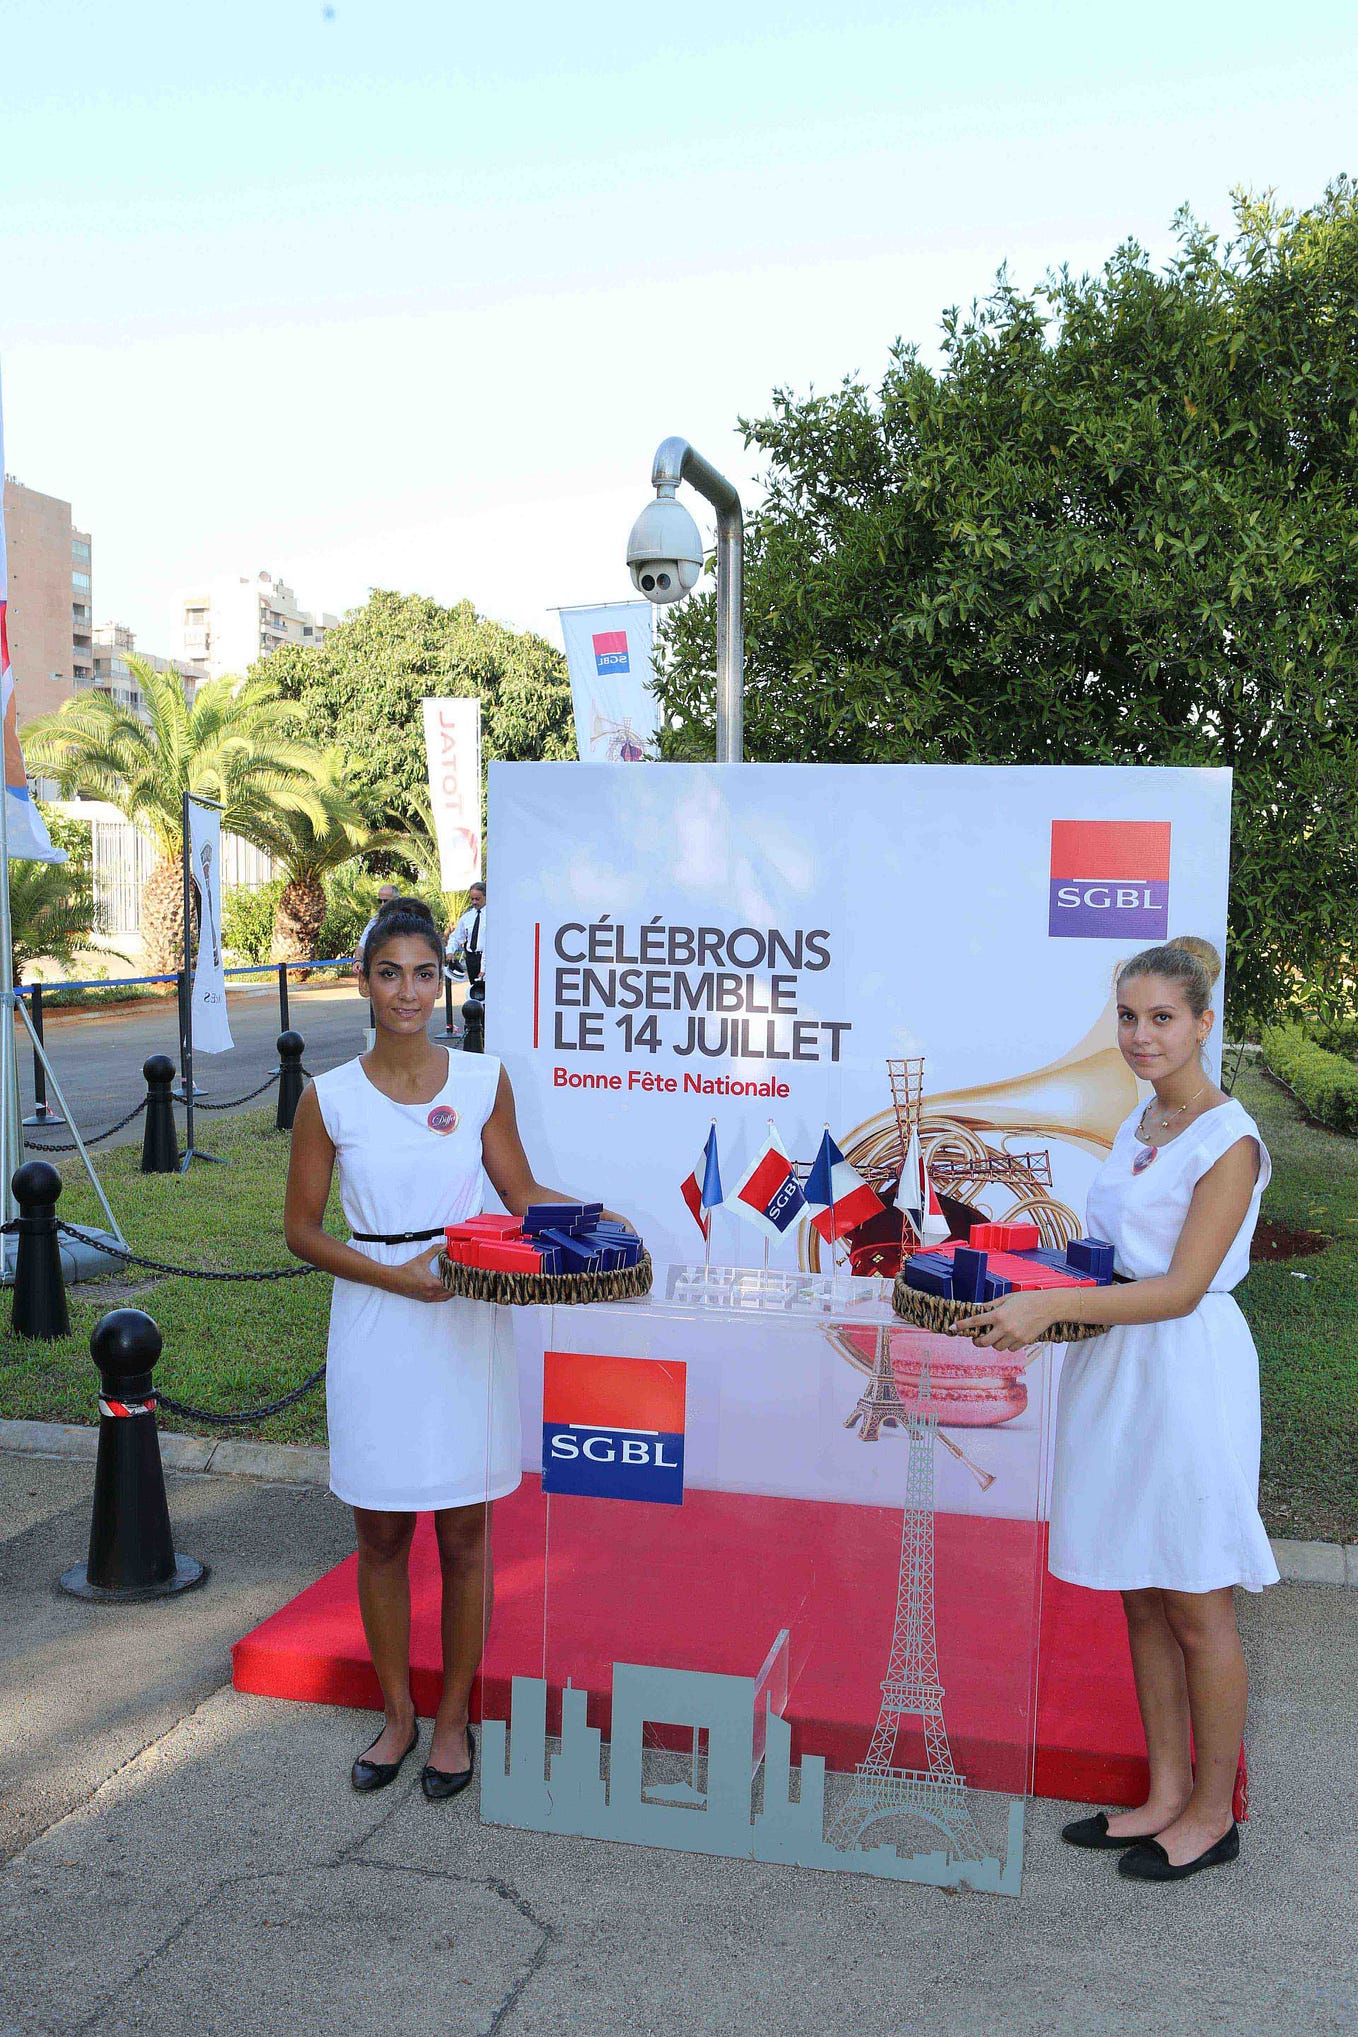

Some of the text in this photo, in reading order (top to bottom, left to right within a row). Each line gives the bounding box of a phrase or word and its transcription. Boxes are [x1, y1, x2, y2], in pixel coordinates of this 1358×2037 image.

[1057, 887, 1163, 910] SGBL
[554, 914, 831, 971] CÉLÉBRONS
[554, 967, 798, 1015] ENSEMBLE
[554, 1011, 852, 1062] LE 14 JUILLET
[553, 1067, 790, 1099] Bonne Fête Nationale
[551, 1434, 678, 1468] SGBL
